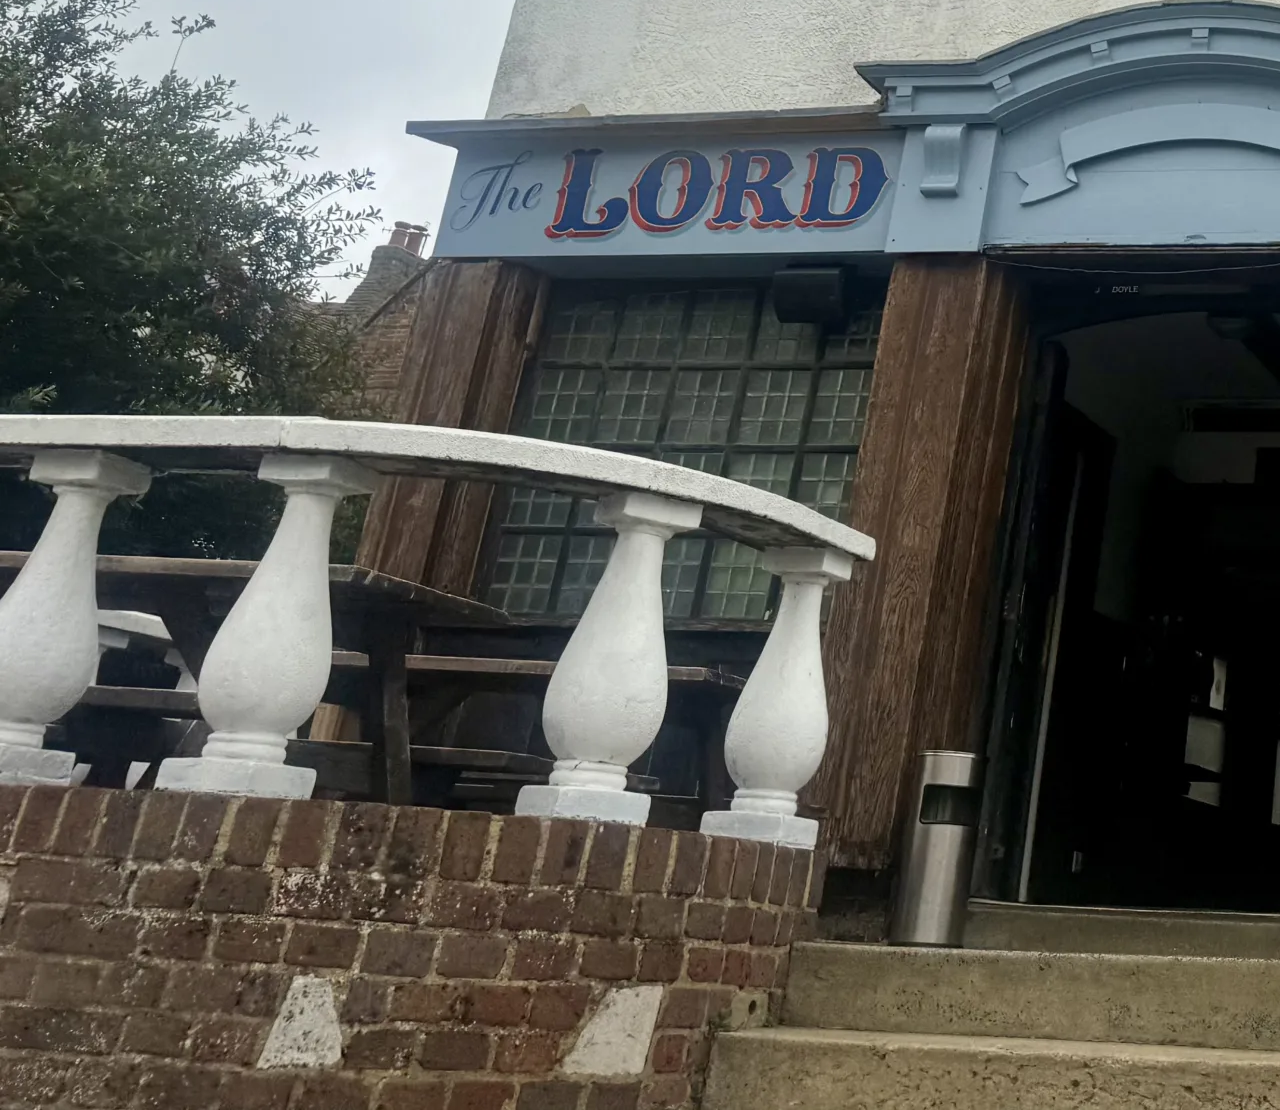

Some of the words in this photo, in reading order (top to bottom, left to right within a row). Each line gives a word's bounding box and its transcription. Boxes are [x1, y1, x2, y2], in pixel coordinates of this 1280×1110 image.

[450, 150, 542, 231] The
[544, 147, 893, 239] LORD
[1111, 285, 1139, 293] DOYLE
